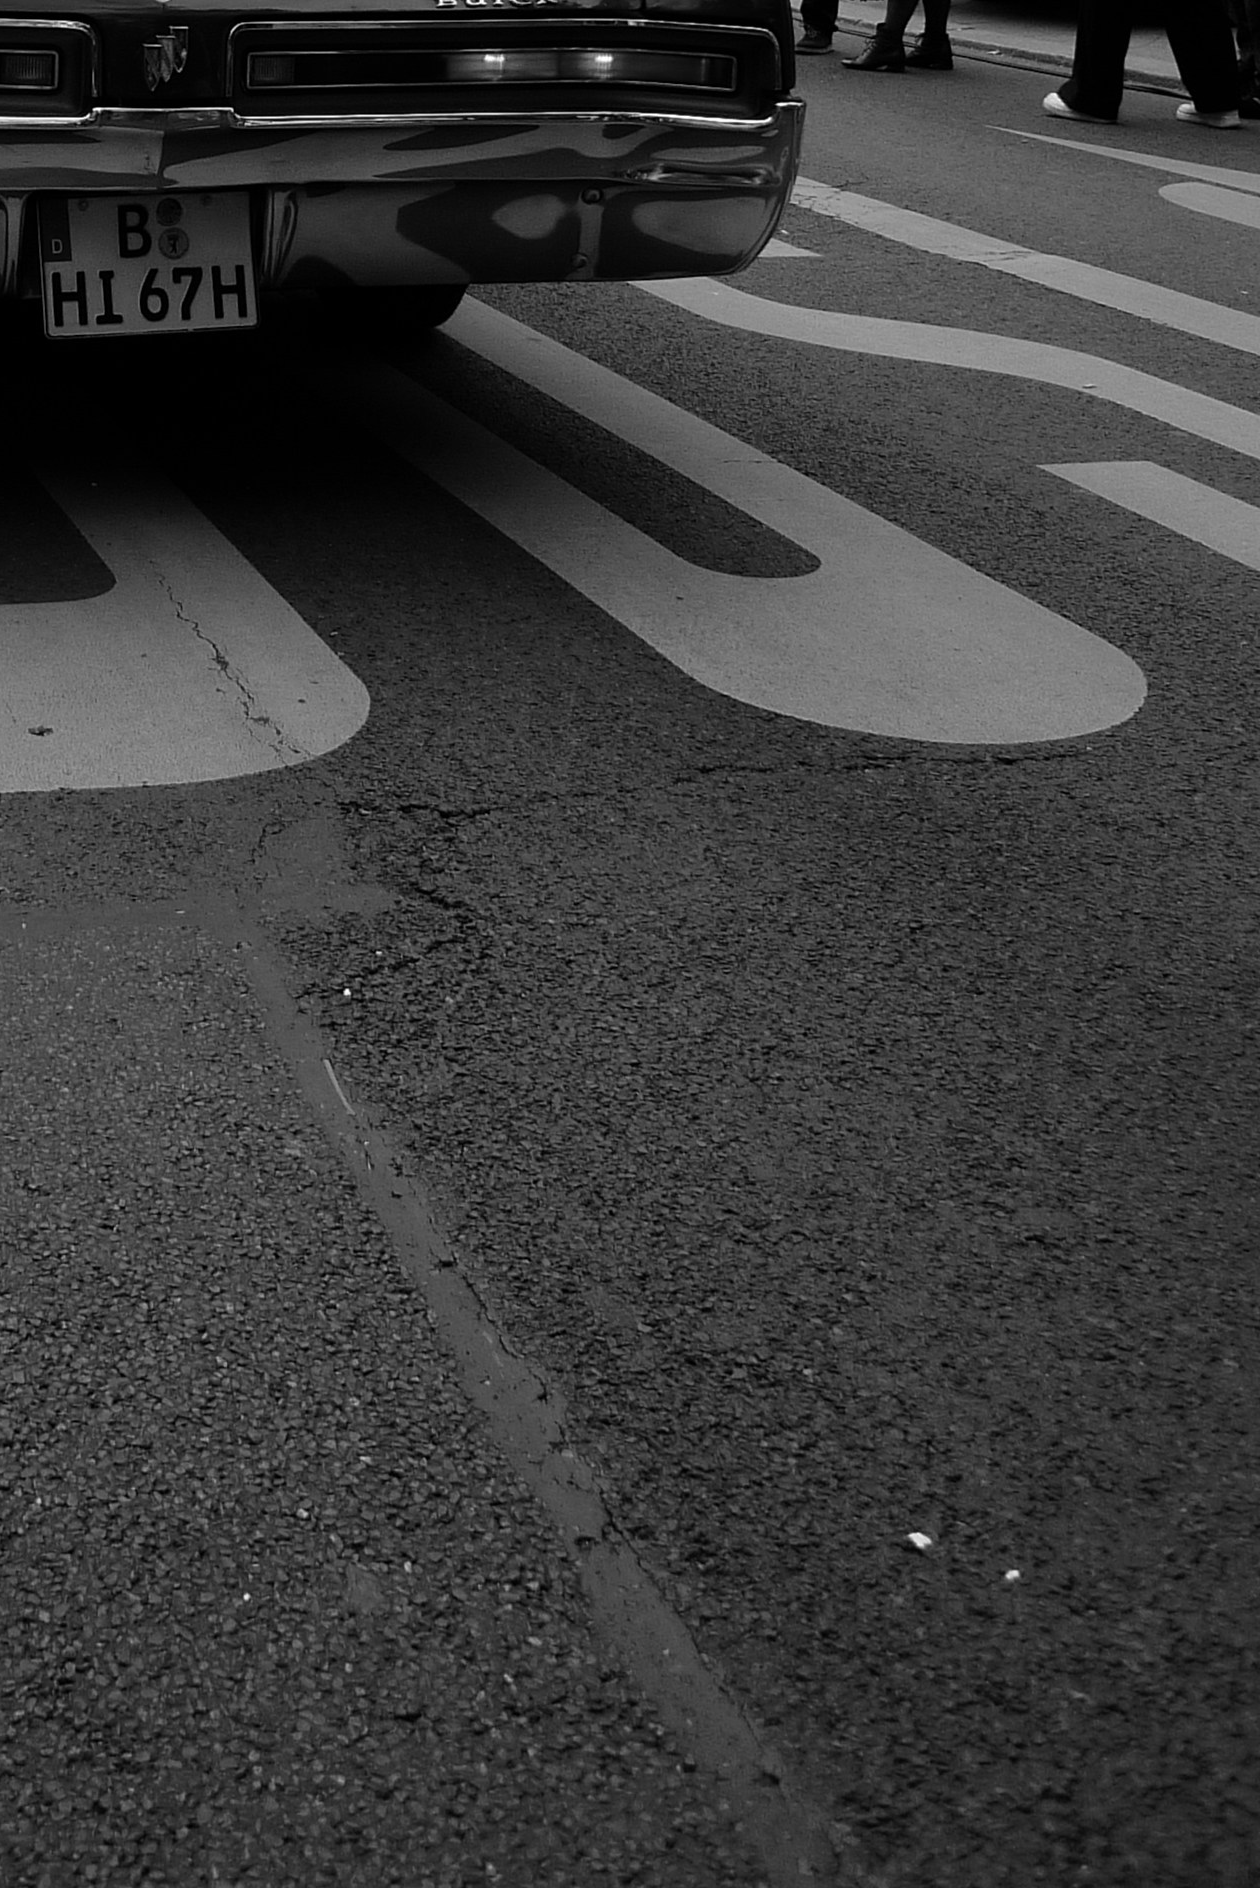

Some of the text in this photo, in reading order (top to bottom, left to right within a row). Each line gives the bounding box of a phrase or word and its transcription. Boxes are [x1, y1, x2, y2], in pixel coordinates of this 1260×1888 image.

[51, 238, 63, 255] D
[117, 203, 152, 259] B
[51, 264, 248, 328] HI 67H
